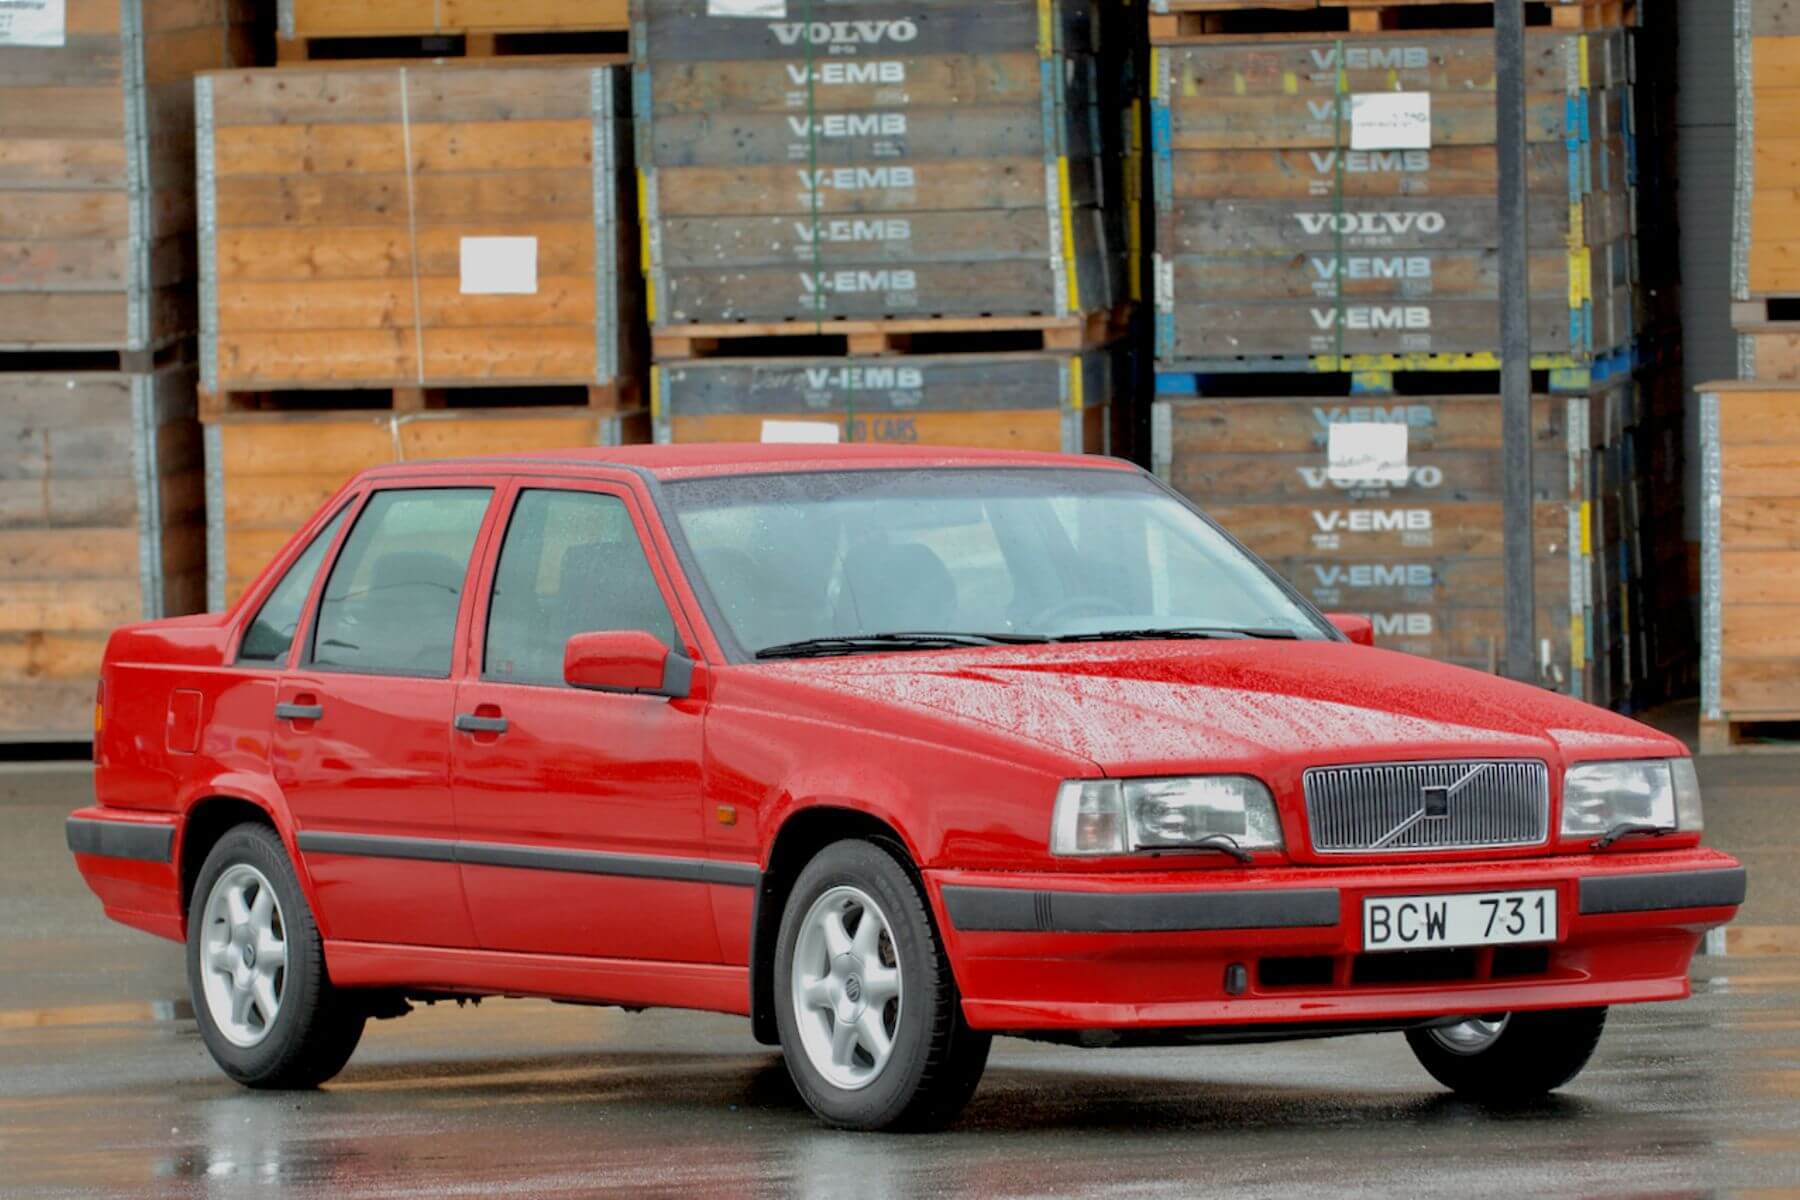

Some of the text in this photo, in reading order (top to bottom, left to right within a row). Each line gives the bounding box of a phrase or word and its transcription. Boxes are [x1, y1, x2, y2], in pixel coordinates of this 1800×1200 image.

[768, 20, 918, 45] VOLVO
[786, 61, 905, 84] V-EMB
[788, 113, 907, 136] V-EMB
[1310, 151, 1430, 173] V-EMB
[797, 166, 914, 189] V-EMB
[1294, 211, 1446, 235] VOLVO
[1311, 256, 1431, 279] V-EMB
[800, 270, 916, 292] V-EMB
[1310, 307, 1431, 329] V-EMB
[805, 367, 923, 390] V-EMB
[1312, 508, 1432, 531] V-EMB
[1313, 565, 1432, 587] V-EMB
[1370, 896, 1545, 943] BCW 731
